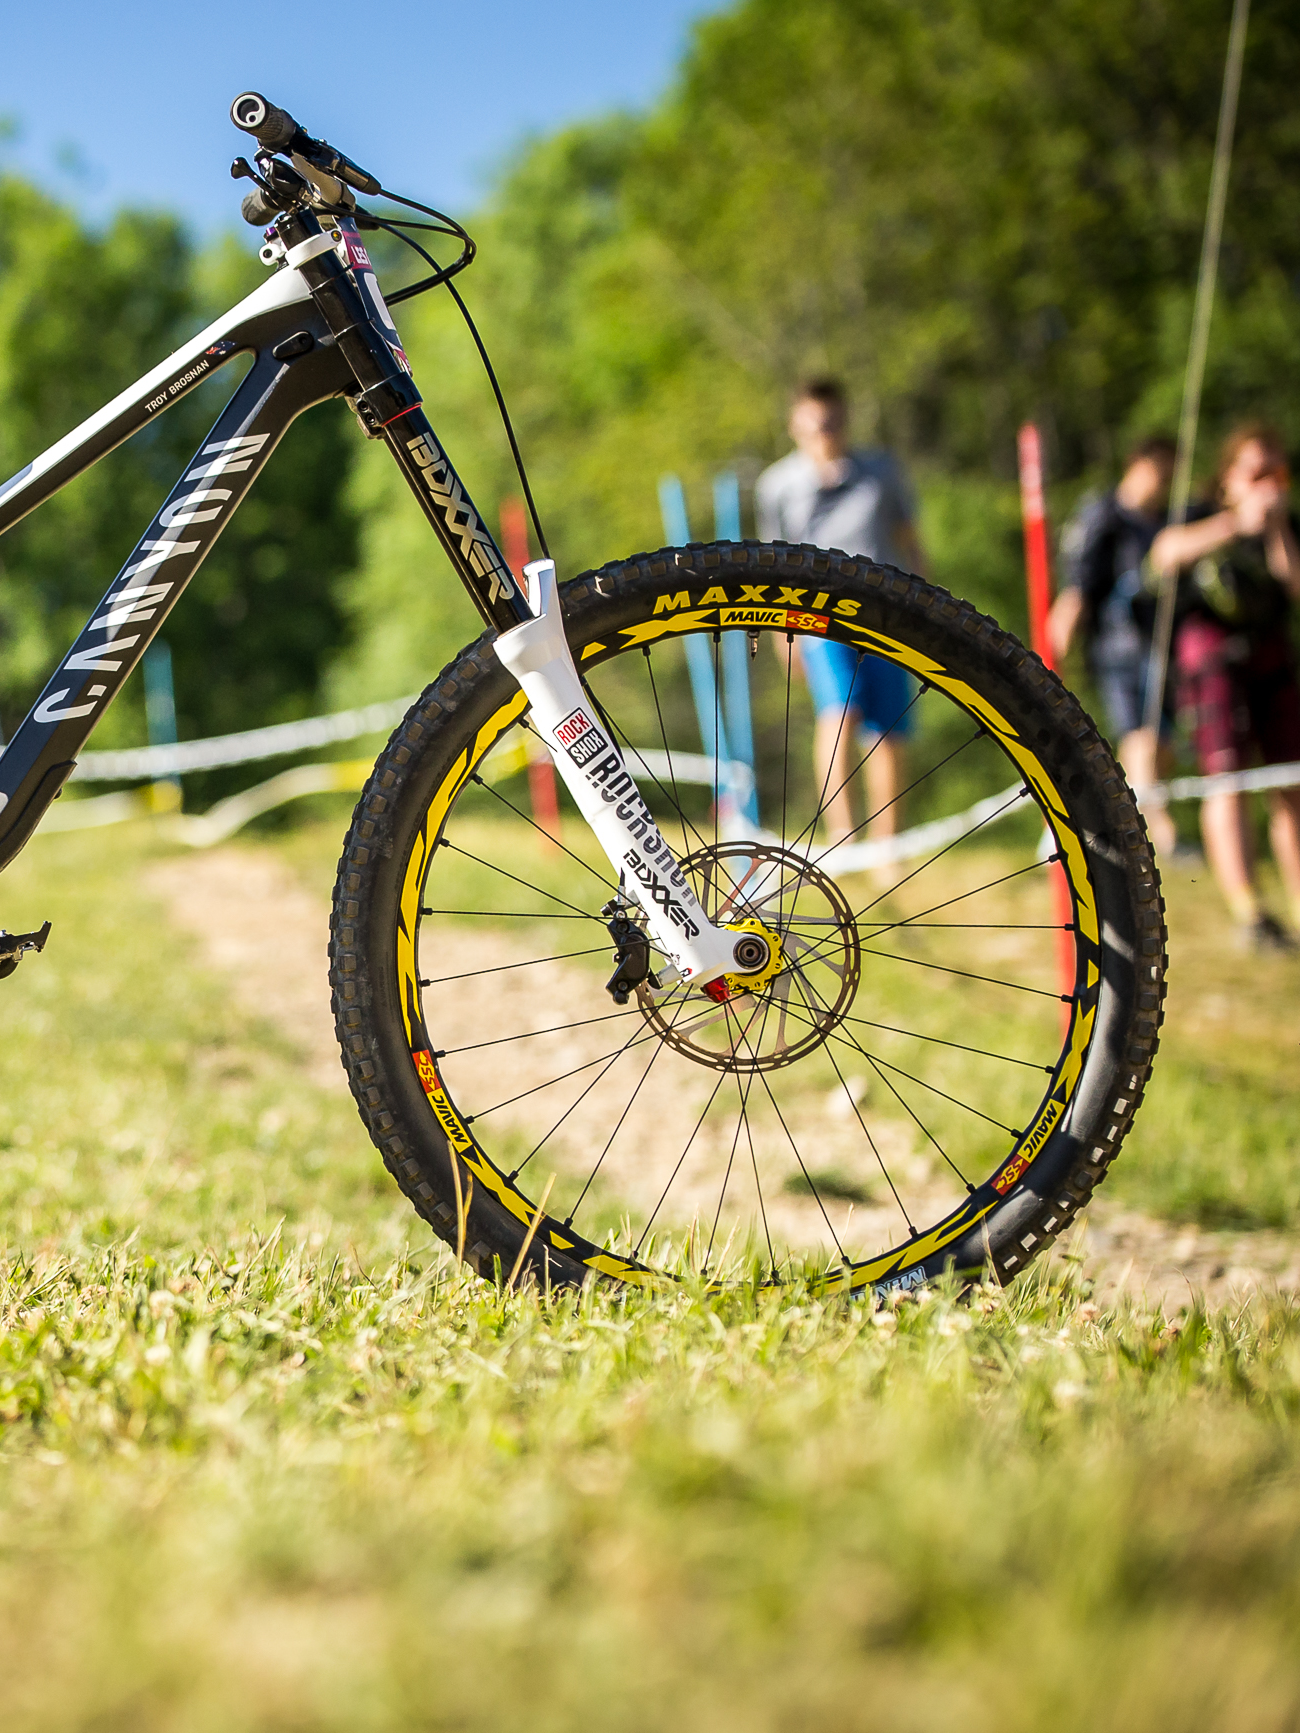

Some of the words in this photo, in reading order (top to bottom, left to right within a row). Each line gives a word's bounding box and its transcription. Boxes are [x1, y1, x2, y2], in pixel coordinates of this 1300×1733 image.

[144, 391, 168, 413] TROY
[168, 359, 210, 395] BROSNAN
[33, 433, 271, 724] CANYON
[652, 585, 862, 616] MAXXIS
[723, 610, 784, 624] MAVIC
[557, 712, 590, 745] ROCK
[570, 730, 605, 764] SHOX
[431, 1095, 469, 1143] MAVIC
[1023, 1102, 1058, 1158] MAVIC
